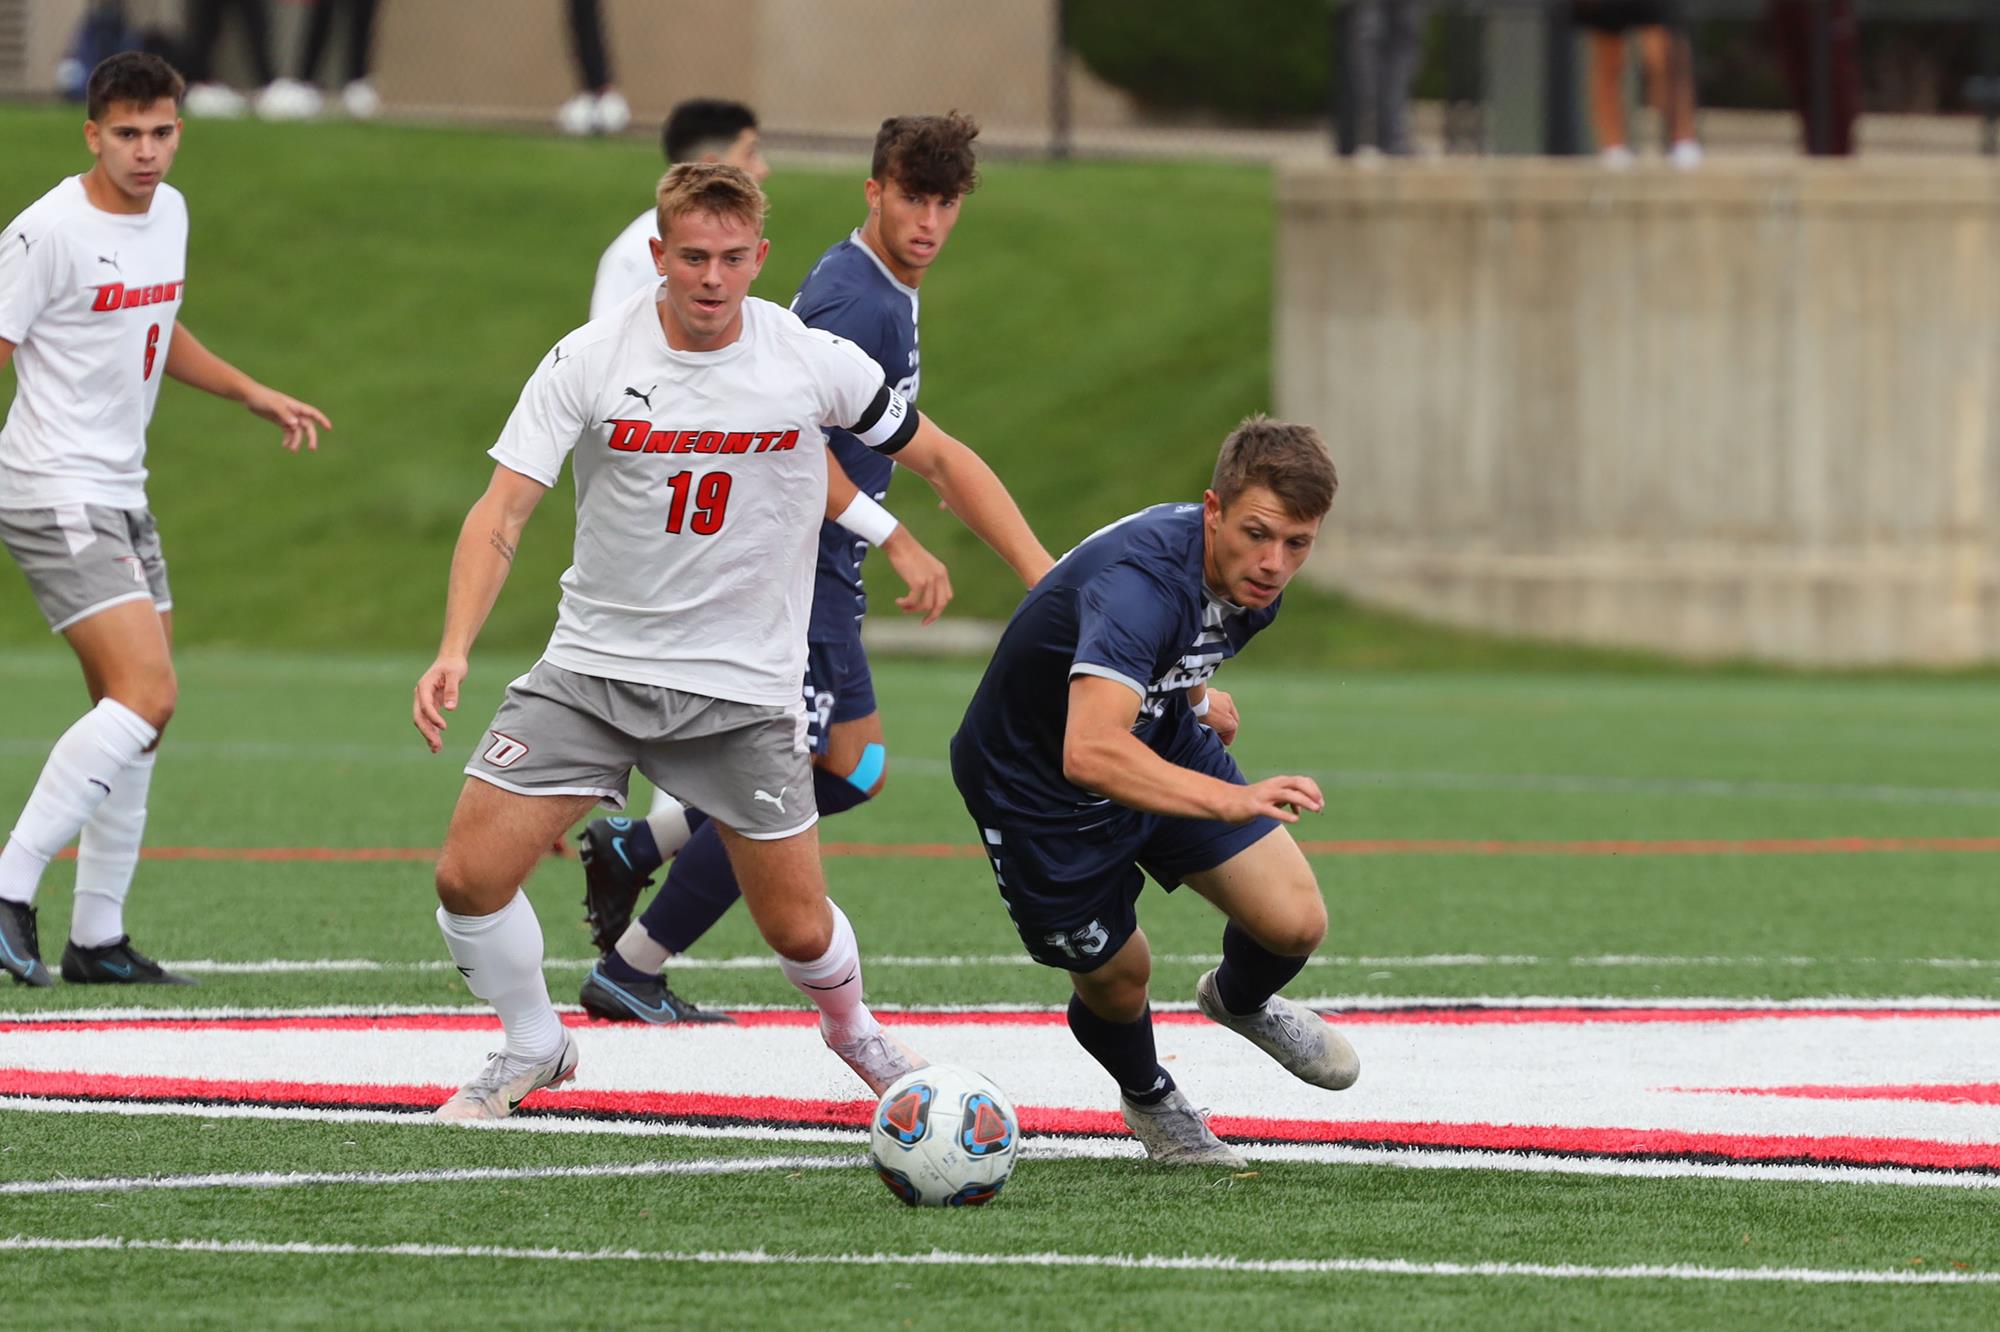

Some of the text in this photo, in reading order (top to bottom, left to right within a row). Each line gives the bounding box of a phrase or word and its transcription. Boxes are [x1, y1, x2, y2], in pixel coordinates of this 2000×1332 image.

[144, 323, 160, 381] 6
[602, 419, 800, 454] ONEONTA
[665, 470, 732, 536] 19
[1045, 918, 1110, 959] 13
